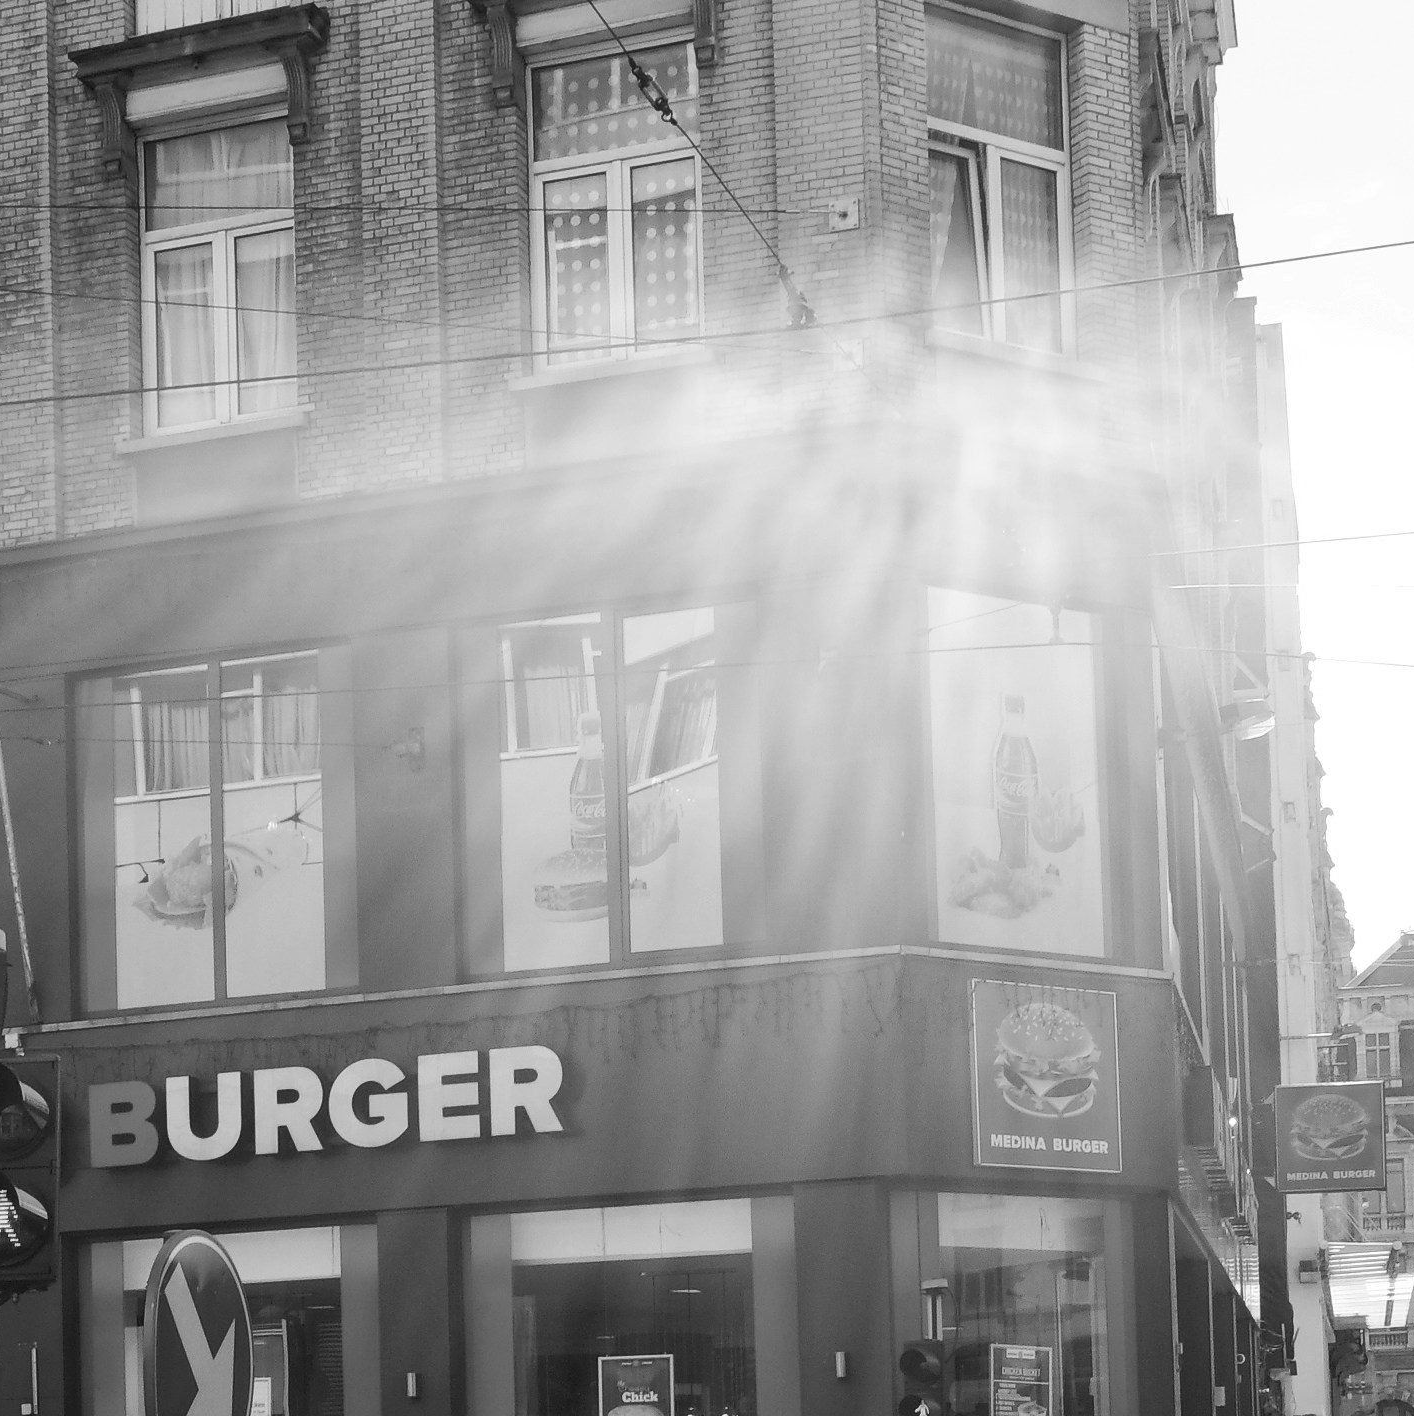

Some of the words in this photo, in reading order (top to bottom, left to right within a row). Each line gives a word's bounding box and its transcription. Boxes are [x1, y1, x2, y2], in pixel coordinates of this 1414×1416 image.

[89, 1046, 563, 1168] BURGER
[990, 1134, 1047, 1151] MEDINA
[1053, 1138, 1109, 1154] BURGER
[1286, 1170, 1329, 1182] MEDINA
[1332, 1168, 1376, 1181] BURGER
[621, 1391, 659, 1403] Chick
